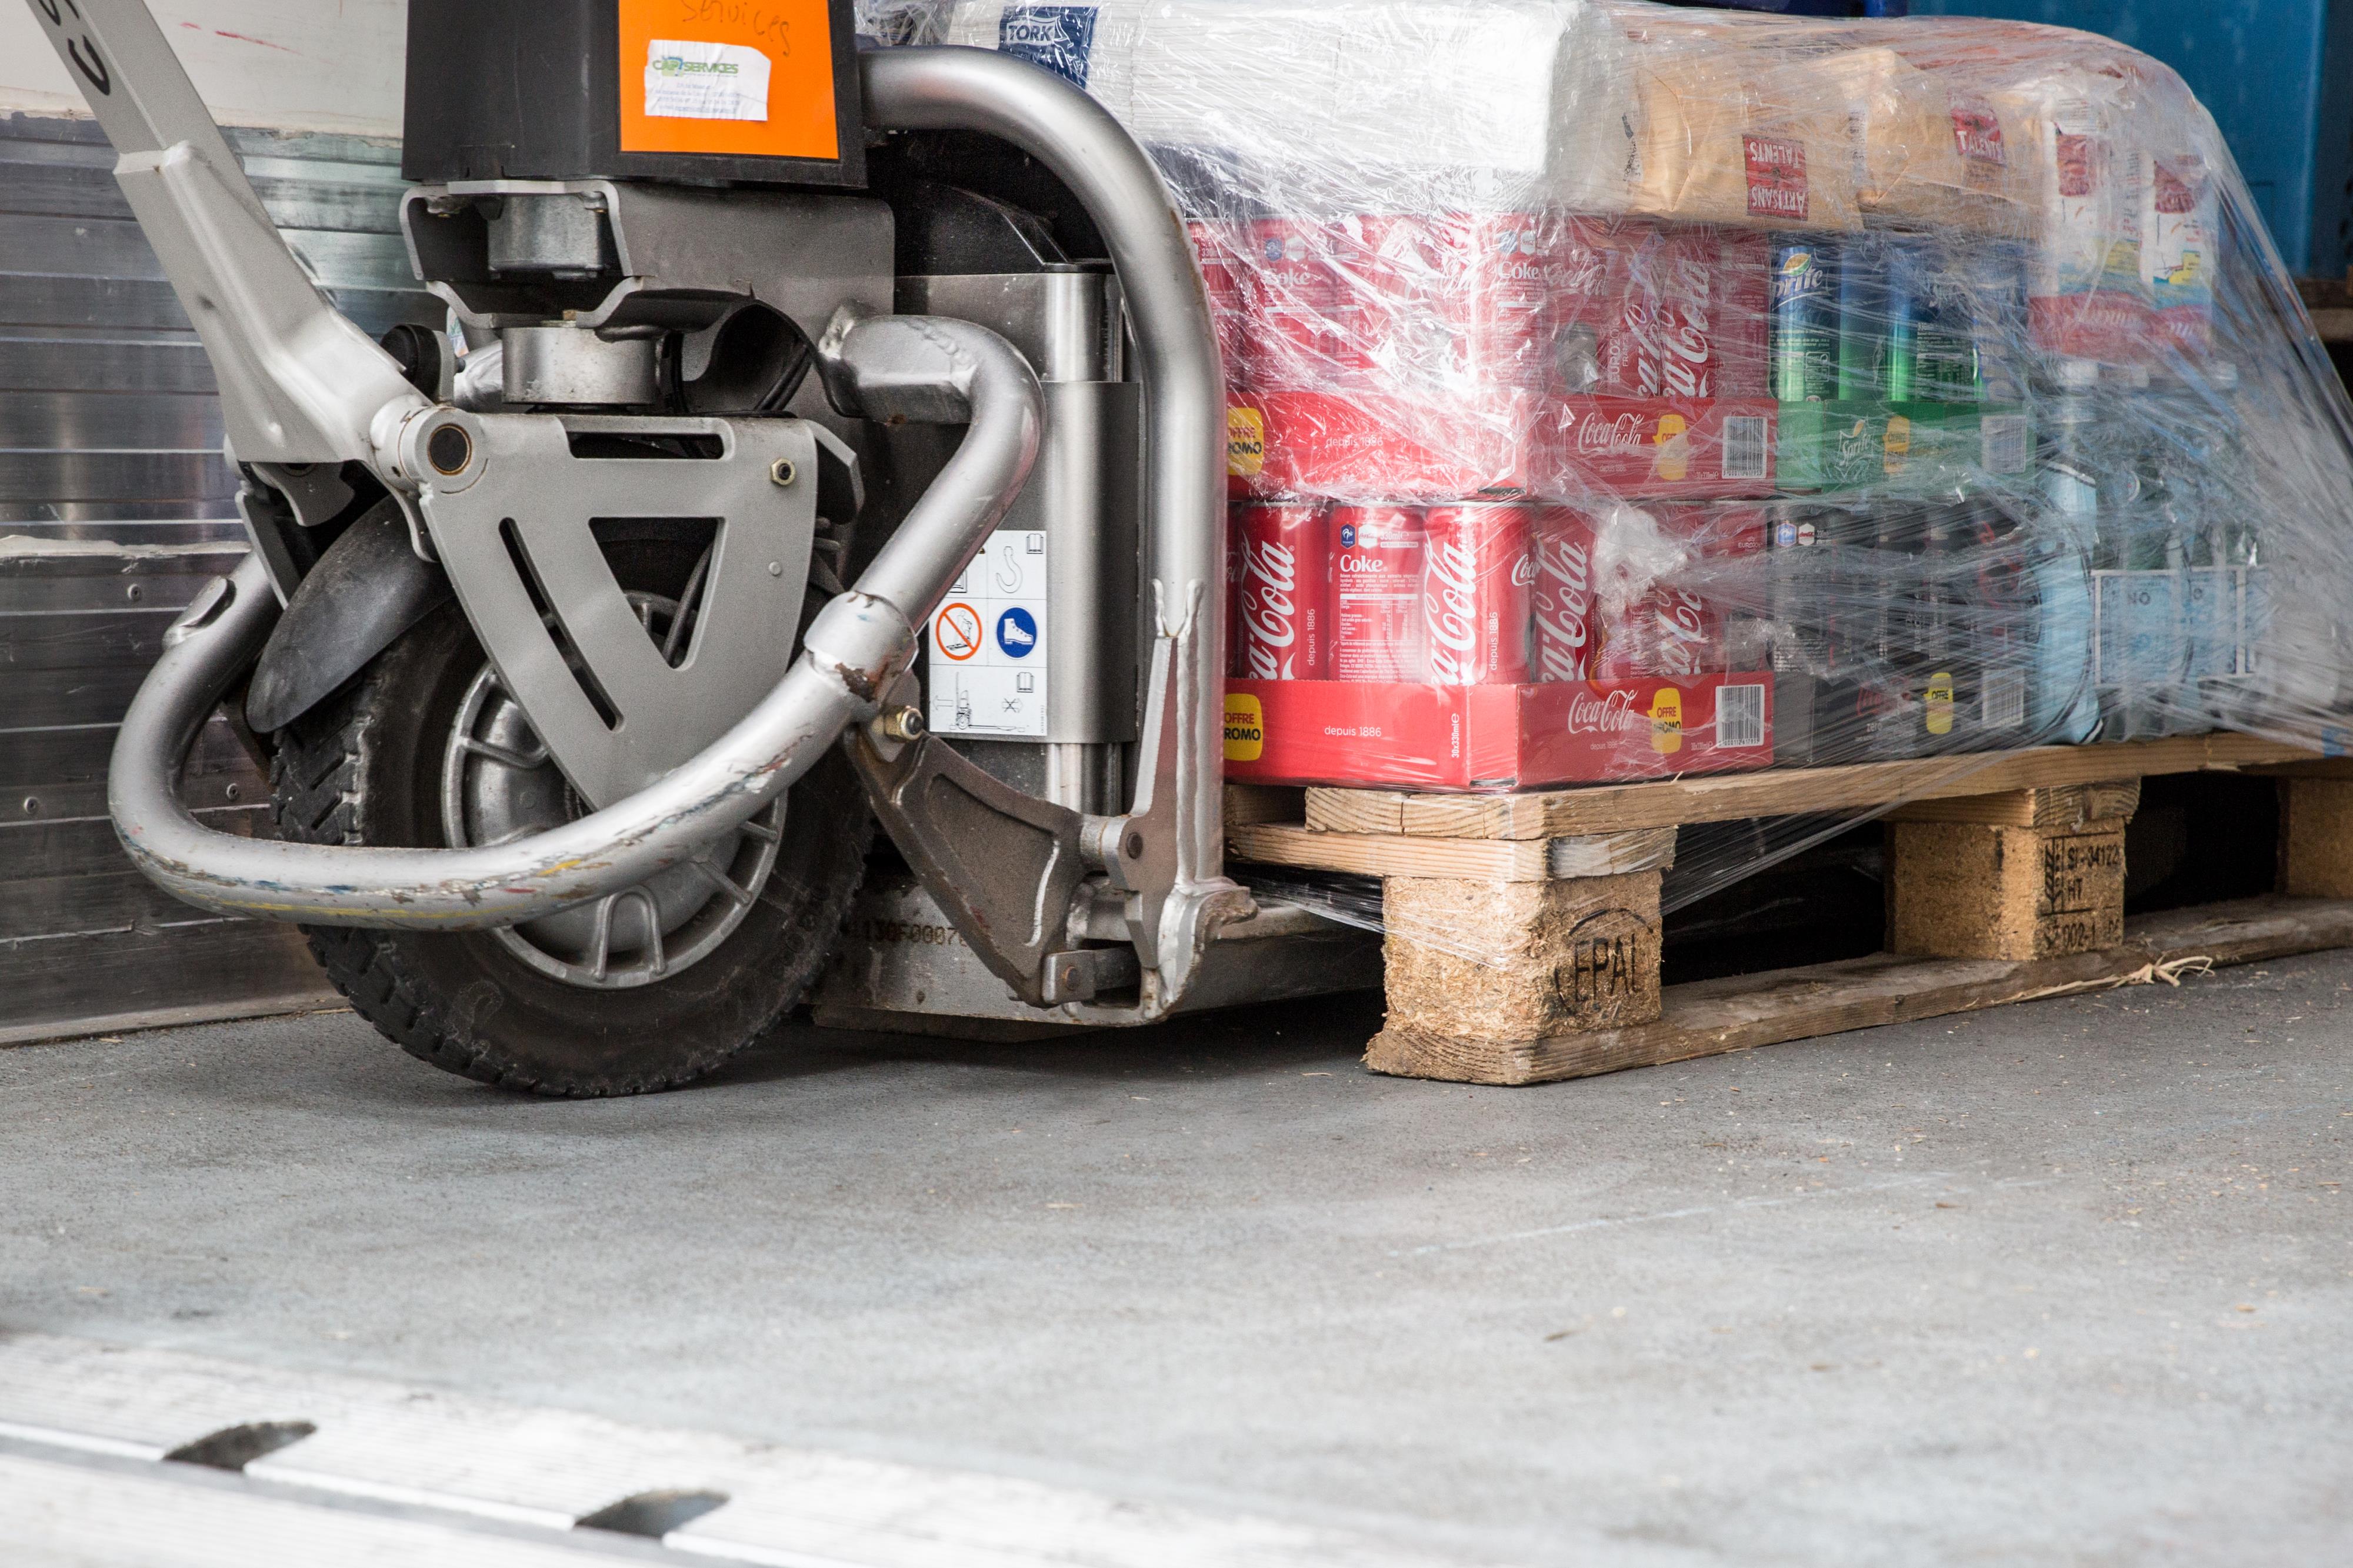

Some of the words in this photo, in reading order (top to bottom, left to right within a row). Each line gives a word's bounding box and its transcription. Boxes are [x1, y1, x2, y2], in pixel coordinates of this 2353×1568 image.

[1008, 25, 1054, 41] TORK
[684, 61, 739, 74] SERVICES
[1749, 141, 1801, 169] TALENTS
[1751, 186, 1806, 215] ARTISANS
[1498, 259, 1539, 279] Coke
[1326, 435, 1357, 449] depuis
[1578, 412, 1645, 454] Coca-Cola
[1842, 433, 1872, 466] Sprite
[1340, 555, 1384, 572] Coke
[1307, 609, 1315, 630] 1886
[1489, 612, 1498, 635] 1886
[1307, 633, 1315, 666] depuis
[1489, 638, 1498, 670] depuis
[1931, 690, 1949, 700] OFFRE
[1224, 713, 1255, 725] OFFRE
[1568, 689, 1638, 735] Coca-Cola
[1657, 707, 1677, 718] OFFRE
[1224, 728, 1261, 741] ROMO
[1324, 725, 1357, 738] depuis
[1359, 726, 1382, 737] 1886
[2068, 877, 2083, 901] HT
[1575, 933, 1638, 1002] EPAL
